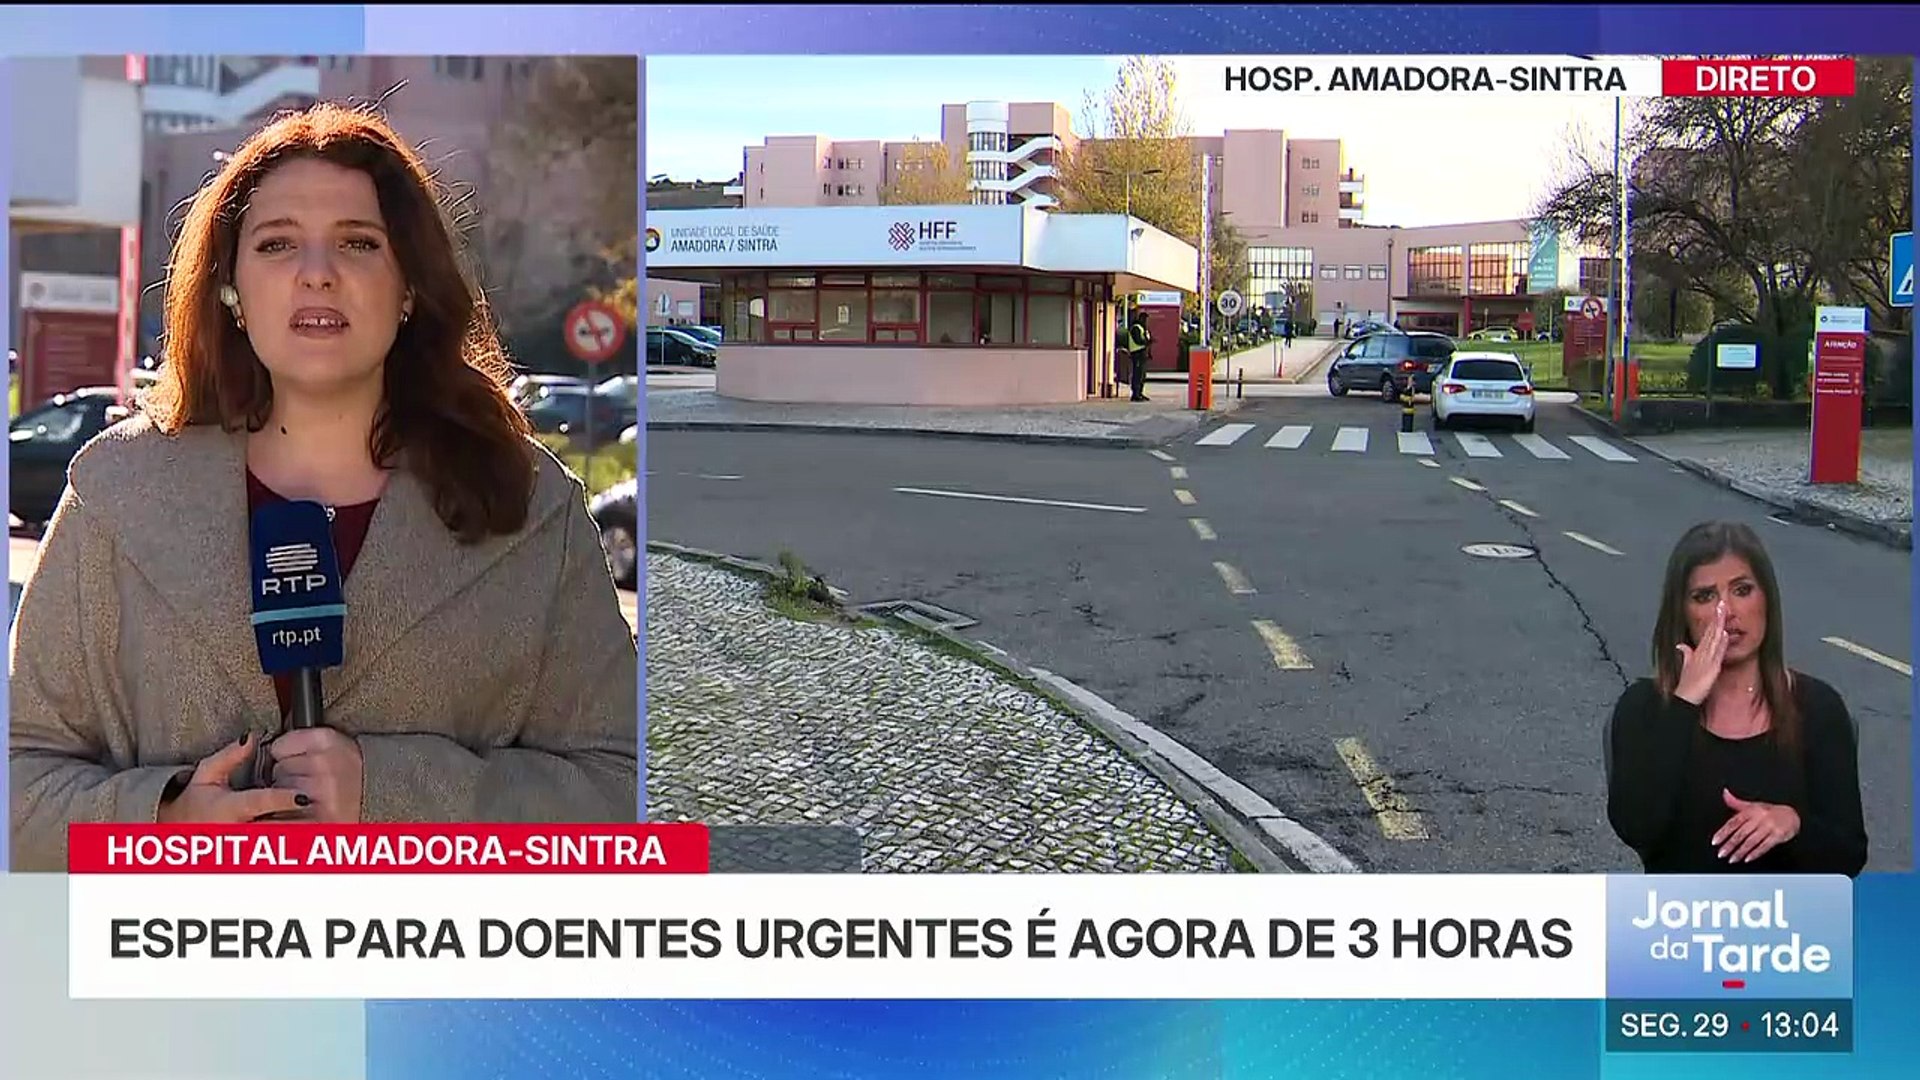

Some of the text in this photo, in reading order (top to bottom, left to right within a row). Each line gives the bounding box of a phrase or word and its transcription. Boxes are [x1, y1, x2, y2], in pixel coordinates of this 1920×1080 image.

[709, 226, 735, 238] LOCAL
[738, 226, 749, 237] DE
[919, 221, 957, 240] HFF
[670, 238, 778, 253] AMADORA / SINTRA
[1221, 298, 1237, 309] 30
[262, 574, 327, 596] RTP
[272, 626, 322, 648] rtp.pt
